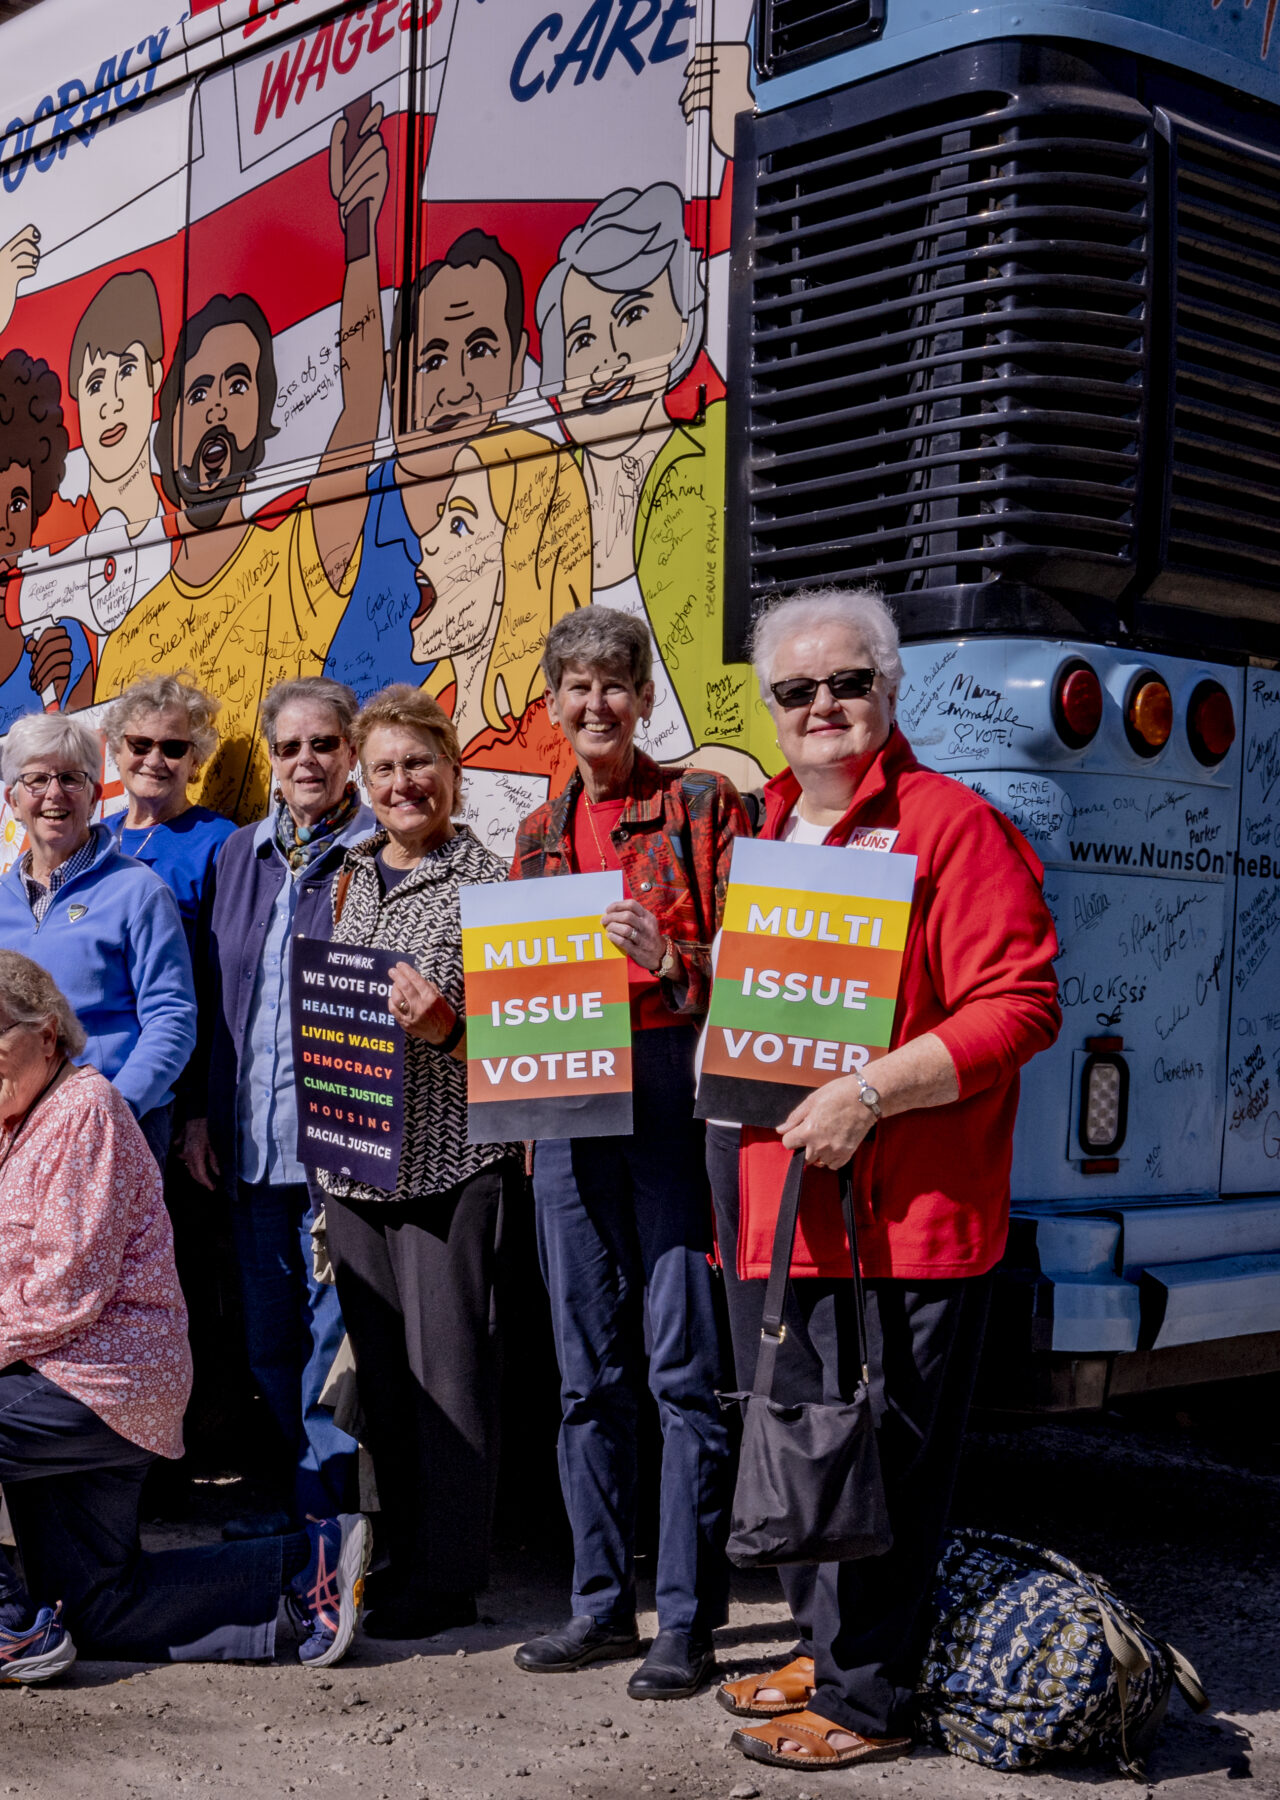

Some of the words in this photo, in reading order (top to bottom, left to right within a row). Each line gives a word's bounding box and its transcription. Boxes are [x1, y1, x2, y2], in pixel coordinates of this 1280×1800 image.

[509, 0, 696, 102] CARE
[509, 0, 696, 102] CARE
[509, 0, 696, 102] CARE
[253, 0, 442, 136] WAGES
[302, 999, 355, 1019] HEALTH
[509, 0, 696, 102] CARE
[949, 673, 1002, 701] Mary
[975, 727, 1014, 748] VOTE!
[1007, 780, 1050, 799] CHERIE
[1184, 806, 1210, 827] Anne
[850, 833, 890, 849] NUNS
[1189, 823, 1222, 848] Parker
[747, 903, 883, 948] MULTI
[483, 932, 604, 970] MULTI
[302, 971, 325, 986] WE
[328, 975, 366, 994] VOTE
[741, 967, 870, 1011] ISSUE
[491, 991, 604, 1027] ISSUE
[301, 1025, 345, 1044] LIVING
[348, 1033, 395, 1054] WAGES
[1237, 1017, 1258, 1037] ON
[303, 1051, 393, 1080] DEMOCRACY
[481, 1049, 616, 1085] VOTER
[722, 1028, 871, 1074] VOTER
[303, 1076, 348, 1097] CLIMATE
[349, 1087, 394, 1107] JUSTICE
[309, 1101, 391, 1133] HOUSING
[306, 1125, 346, 1147] RACIAL
[347, 1137, 392, 1160] JUSTICE
